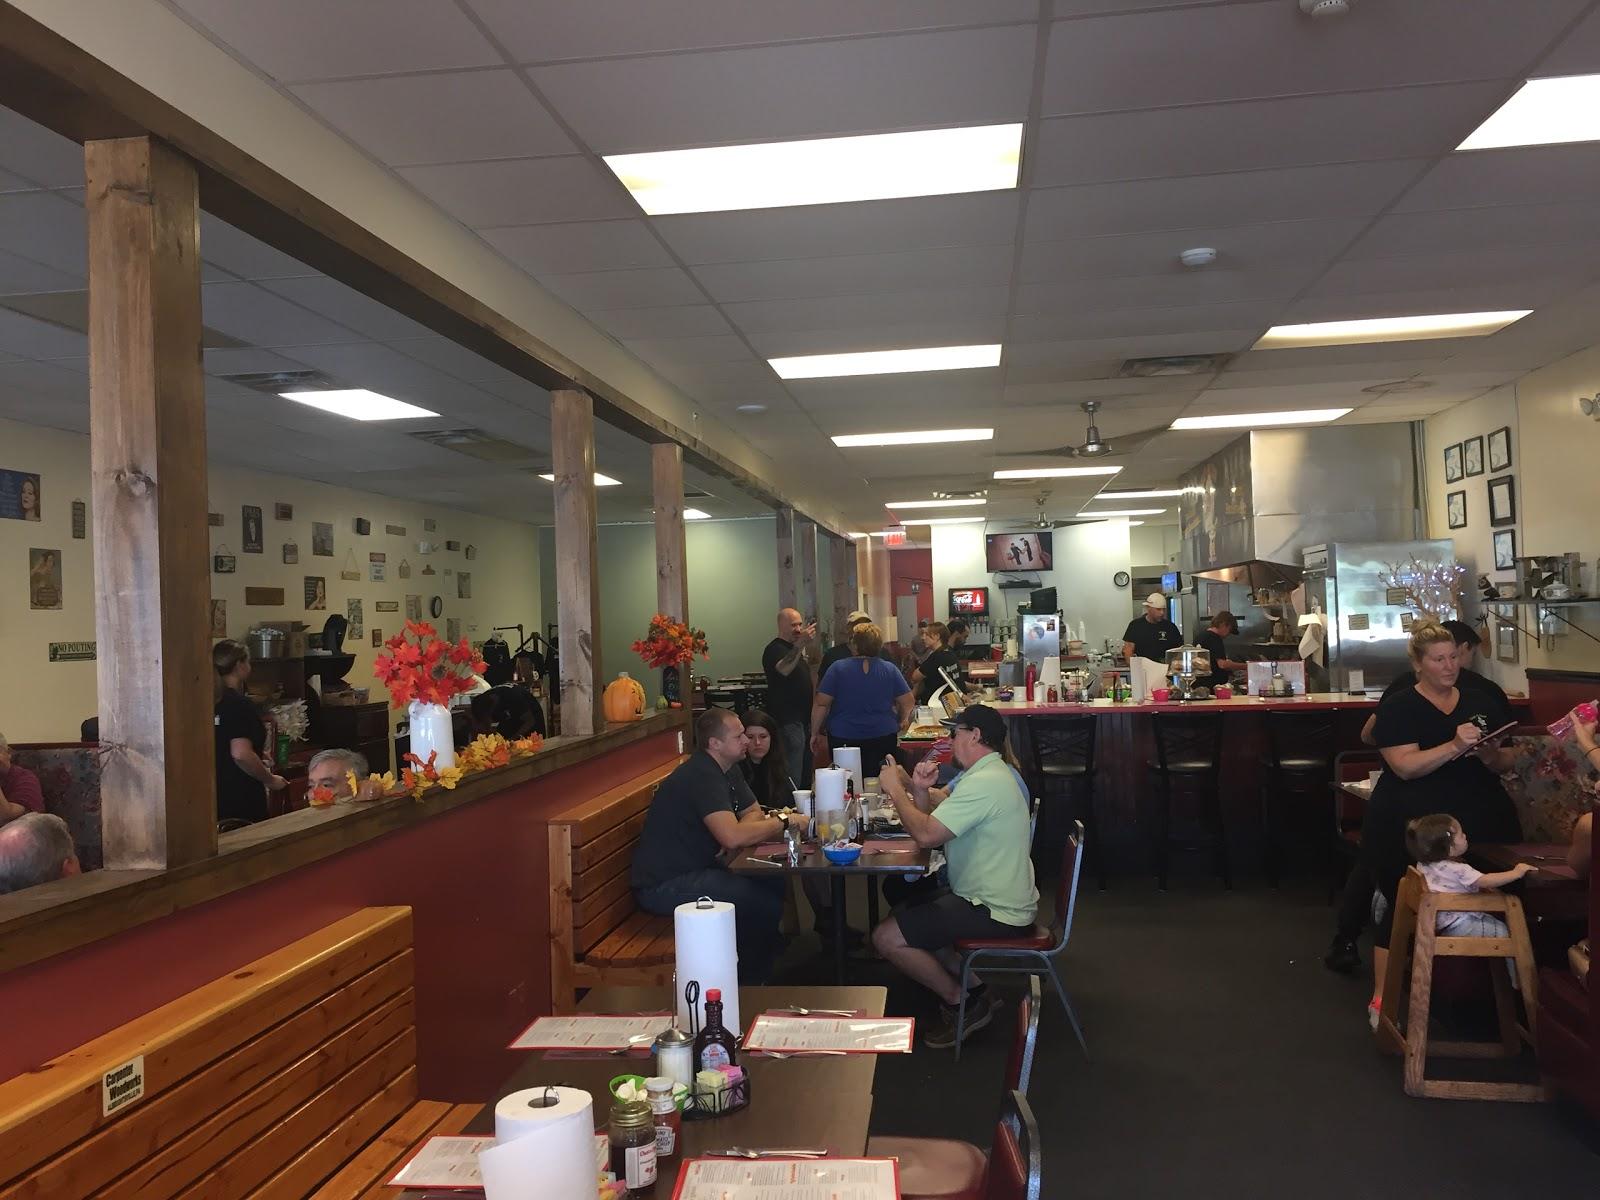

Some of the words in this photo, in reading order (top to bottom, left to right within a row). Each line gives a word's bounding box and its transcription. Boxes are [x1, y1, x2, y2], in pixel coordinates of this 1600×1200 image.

[68, 642, 96, 652] POUTING
[106, 1063, 133, 1088] Carpenter
[110, 1074, 141, 1101] Woodworks
